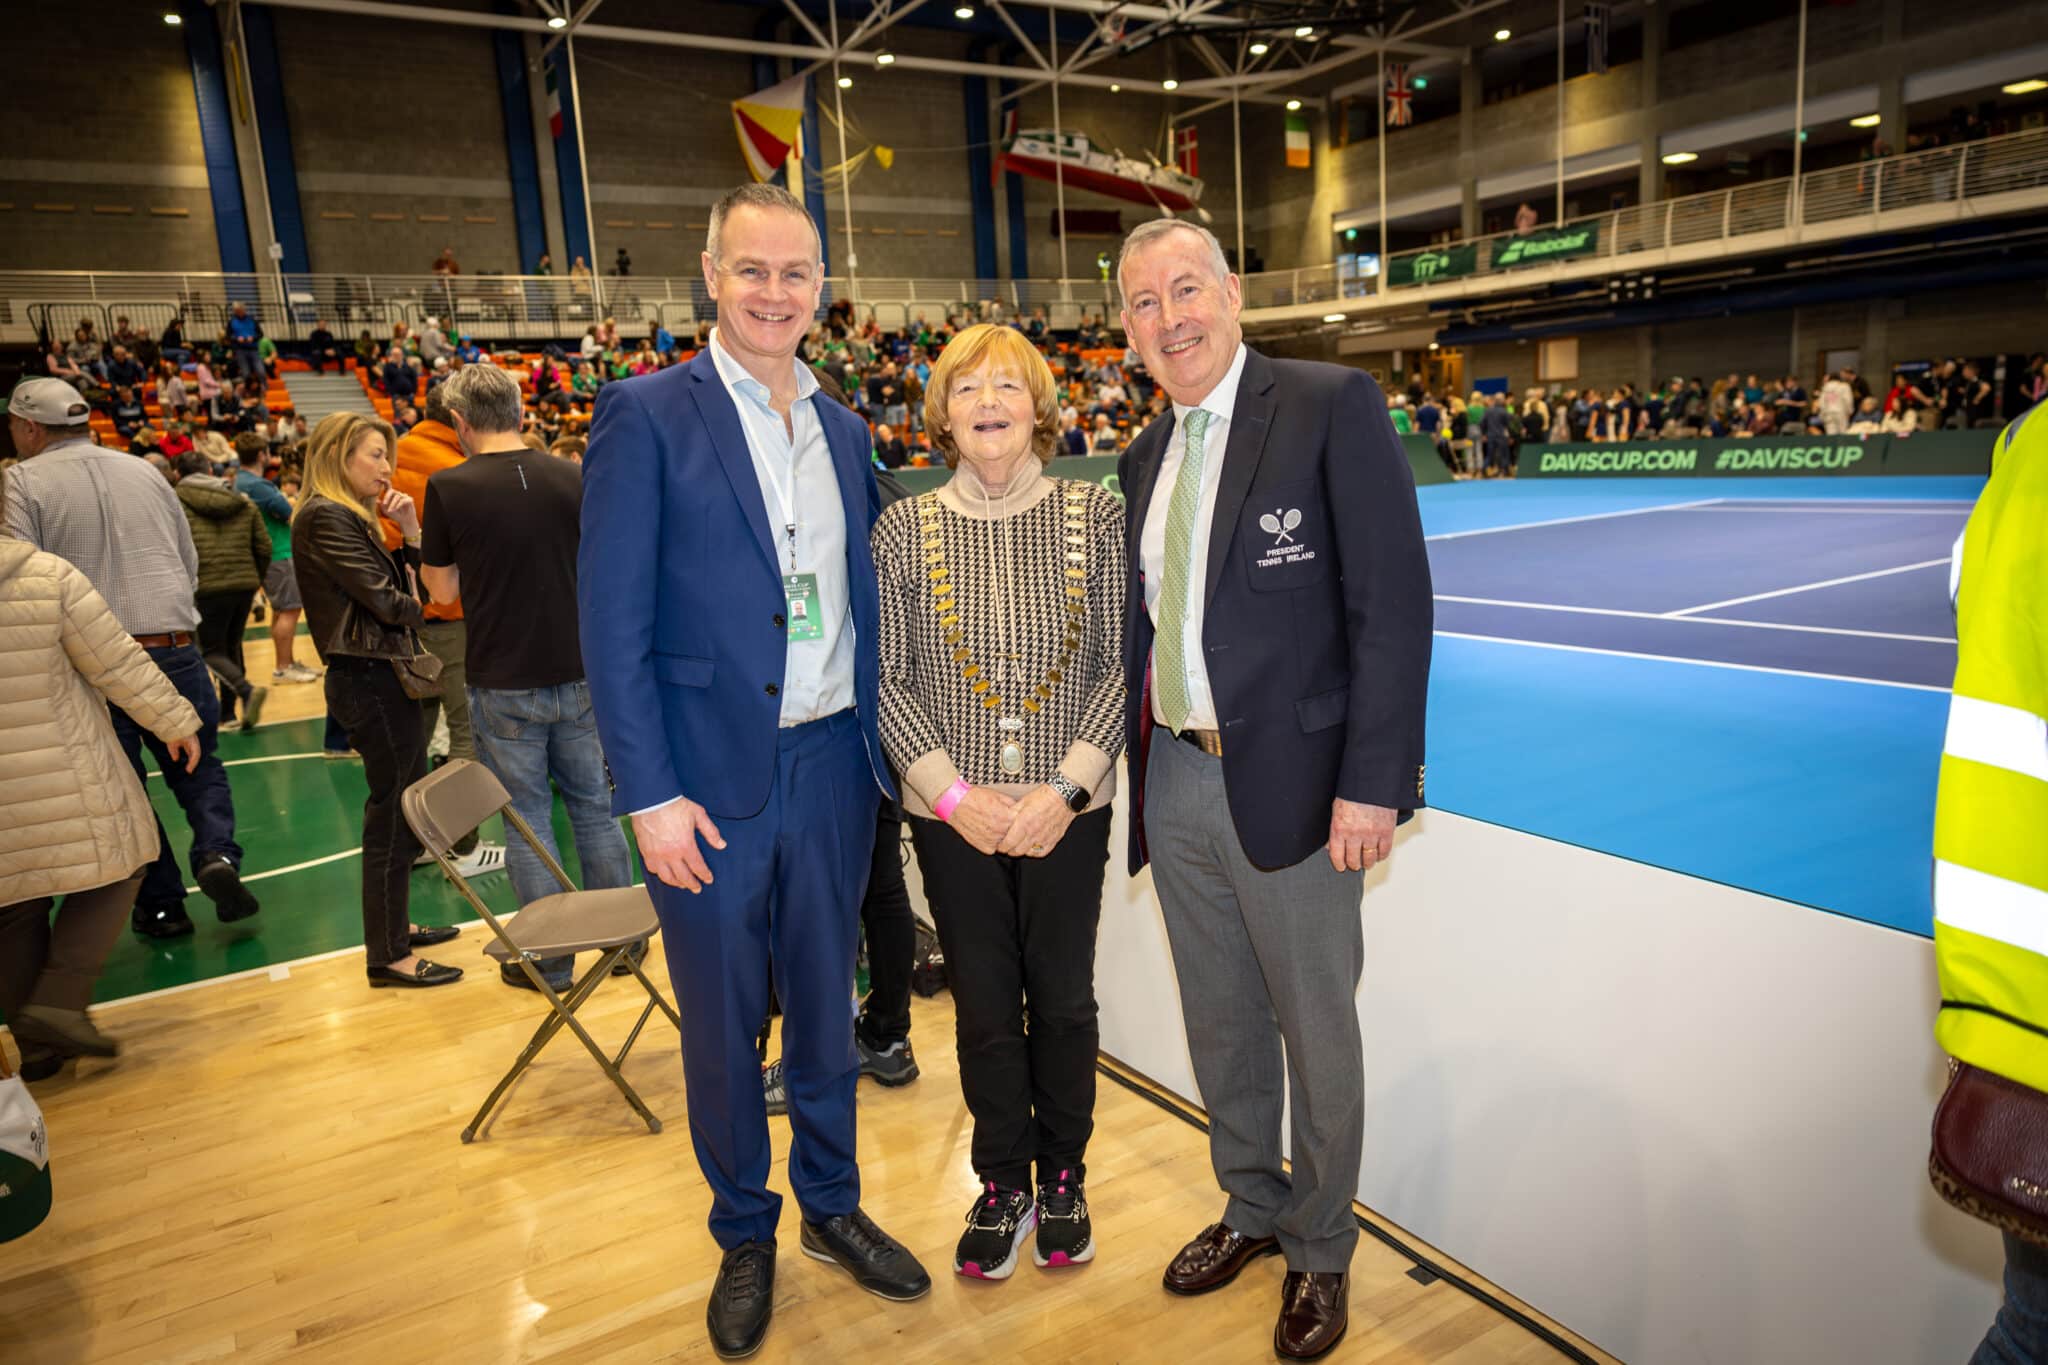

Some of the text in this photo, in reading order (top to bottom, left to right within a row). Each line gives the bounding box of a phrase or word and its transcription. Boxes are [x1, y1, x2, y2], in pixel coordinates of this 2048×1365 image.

[1540, 446, 1864, 472] DAVISCUP.COM #DAVISCUP
[1266, 544, 1305, 557] PRESIDENT
[1256, 551, 1316, 568] TENNIS IRELAND
